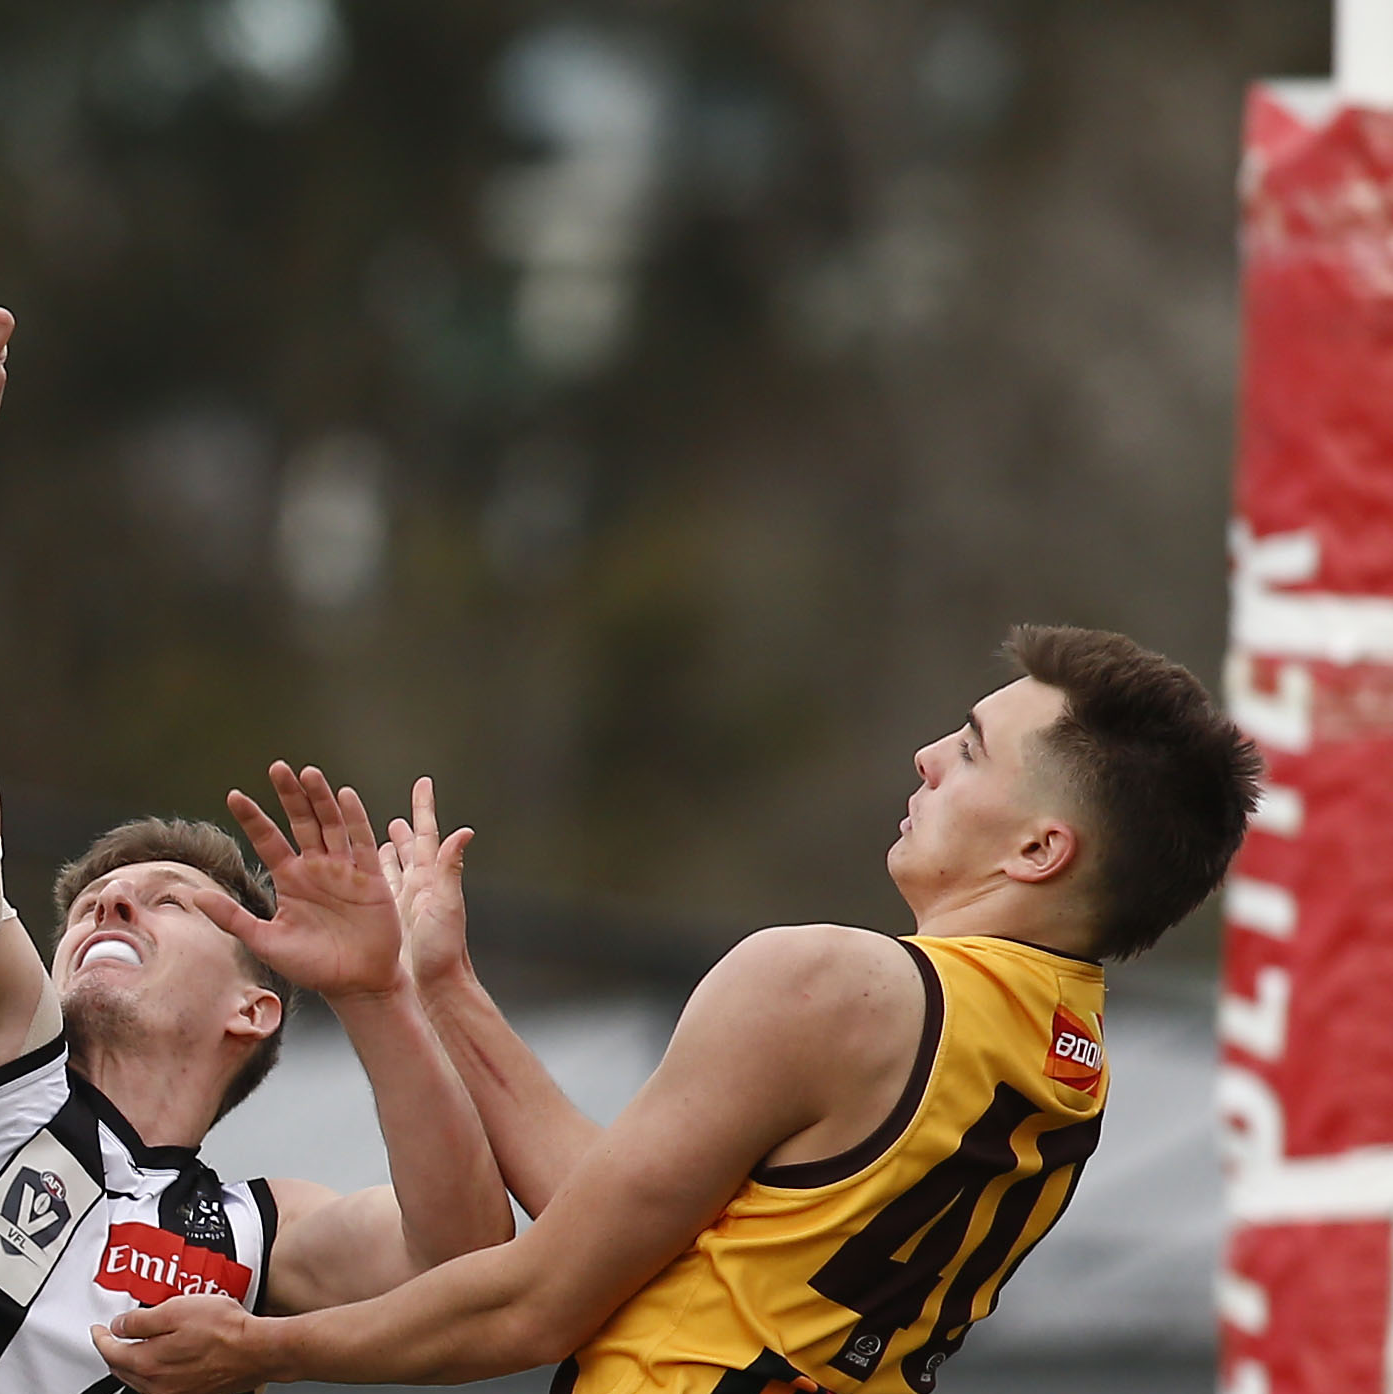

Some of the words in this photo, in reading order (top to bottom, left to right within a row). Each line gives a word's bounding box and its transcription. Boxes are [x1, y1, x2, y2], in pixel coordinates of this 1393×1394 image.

[43, 1173, 64, 1199] AFL
[7, 1227, 27, 1250] VFL
[106, 1244, 239, 1303] Emirat
